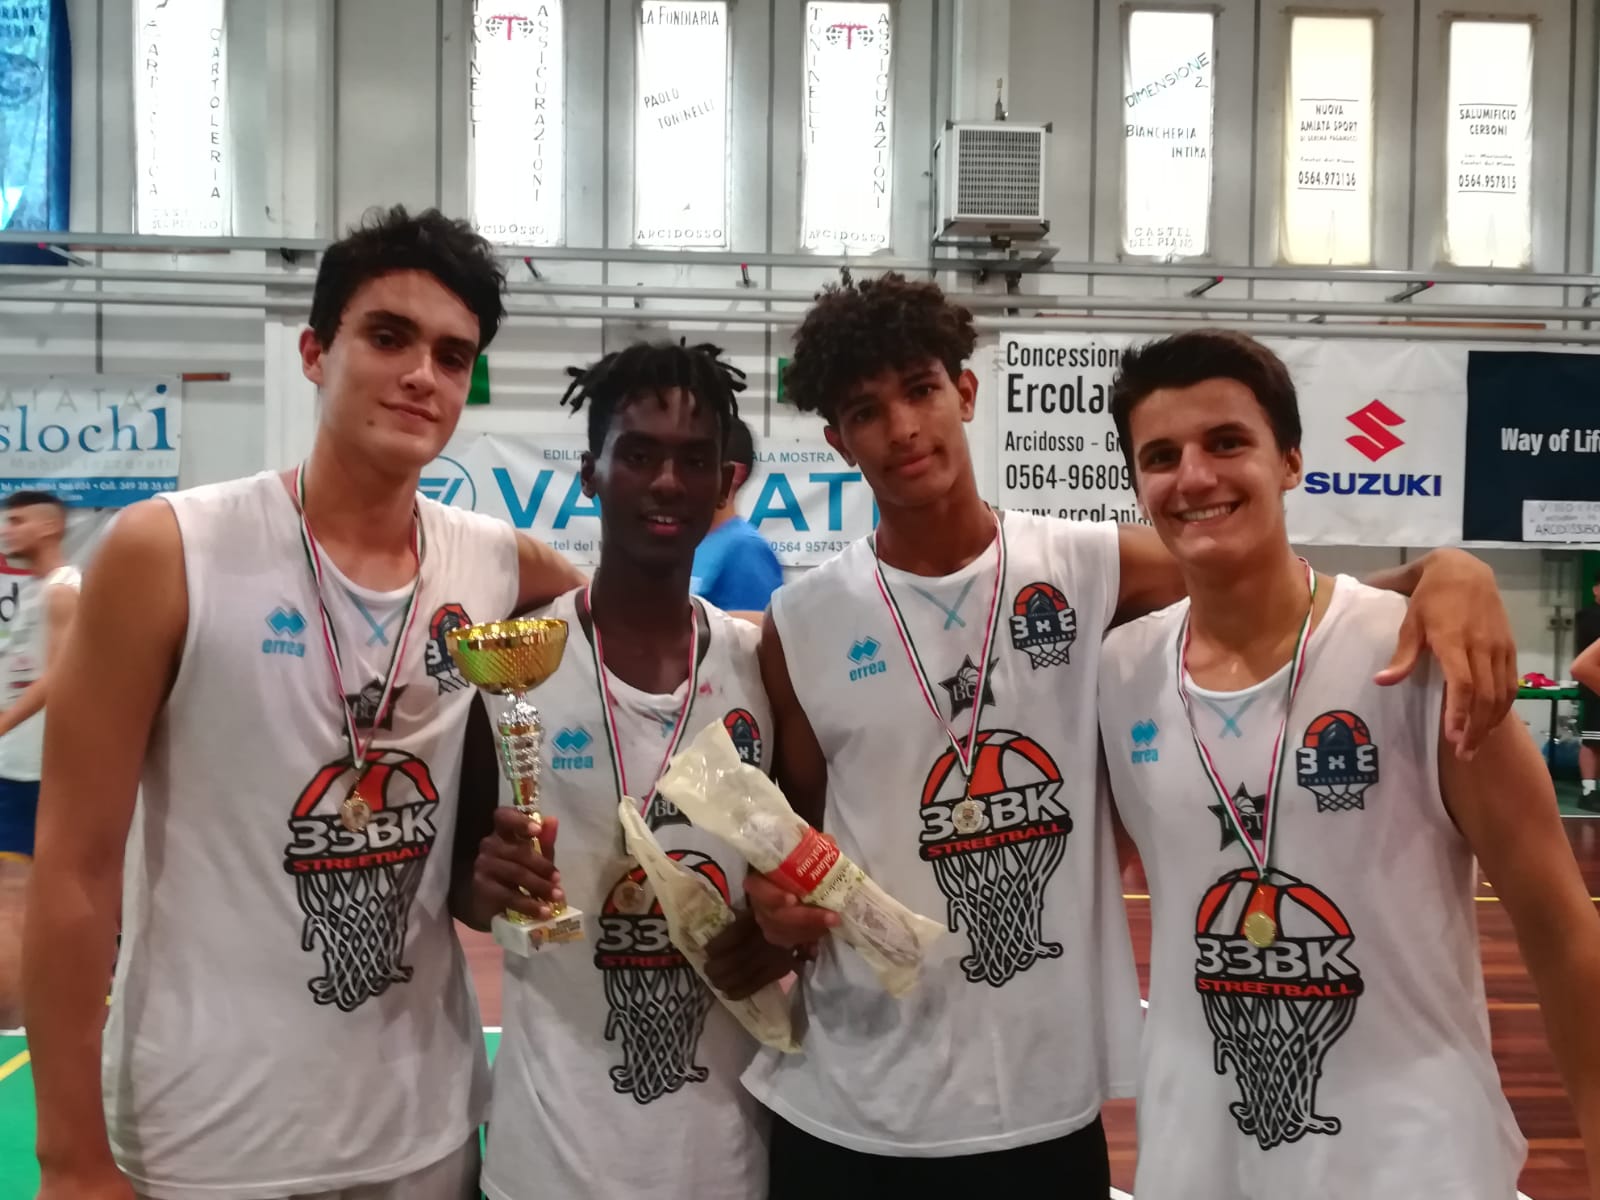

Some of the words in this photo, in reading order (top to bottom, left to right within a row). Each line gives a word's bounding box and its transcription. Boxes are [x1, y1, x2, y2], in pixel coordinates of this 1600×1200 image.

[1125, 52, 1210, 108] DIMENSIONE
[1194, 76, 1208, 88] 2
[534, 5, 549, 202] ASSICURAZIONI
[644, 88, 680, 108] PAOLO
[874, 13, 889, 209] ASSICURAZIONI
[1316, 104, 1344, 115] NUOVA
[1459, 108, 1517, 120] SALUMIFICIO
[1126, 124, 1197, 139] BIANCHERIA
[1300, 120, 1330, 131] AMIATA
[1333, 121, 1358, 132] SPORT
[1469, 124, 1508, 136] CERBONI
[1459, 174, 1517, 189] 0564.957815
[638, 229, 722, 240] ARCIDOSSO
[808, 230, 886, 243] ARCIDOSSO
[1006, 340, 1119, 368] Concession
[1005, 431, 1084, 452] Arcidosso
[1501, 427, 1544, 456] Way
[1548, 428, 1570, 452] of
[1574, 429, 1600, 453] Lif
[780, 452, 835, 463] MOSTRA
[1304, 471, 1442, 497] SUZUKI
[574, 540, 593, 551] del
[771, 541, 800, 552] 0564
[849, 659, 887, 682] errea
[552, 754, 594, 770] errea
[928, 823, 1066, 858] STREETBALL
[292, 844, 431, 873] STREETBALL
[1196, 936, 1360, 981] 33BK
[1197, 977, 1357, 998] STREETBALL
